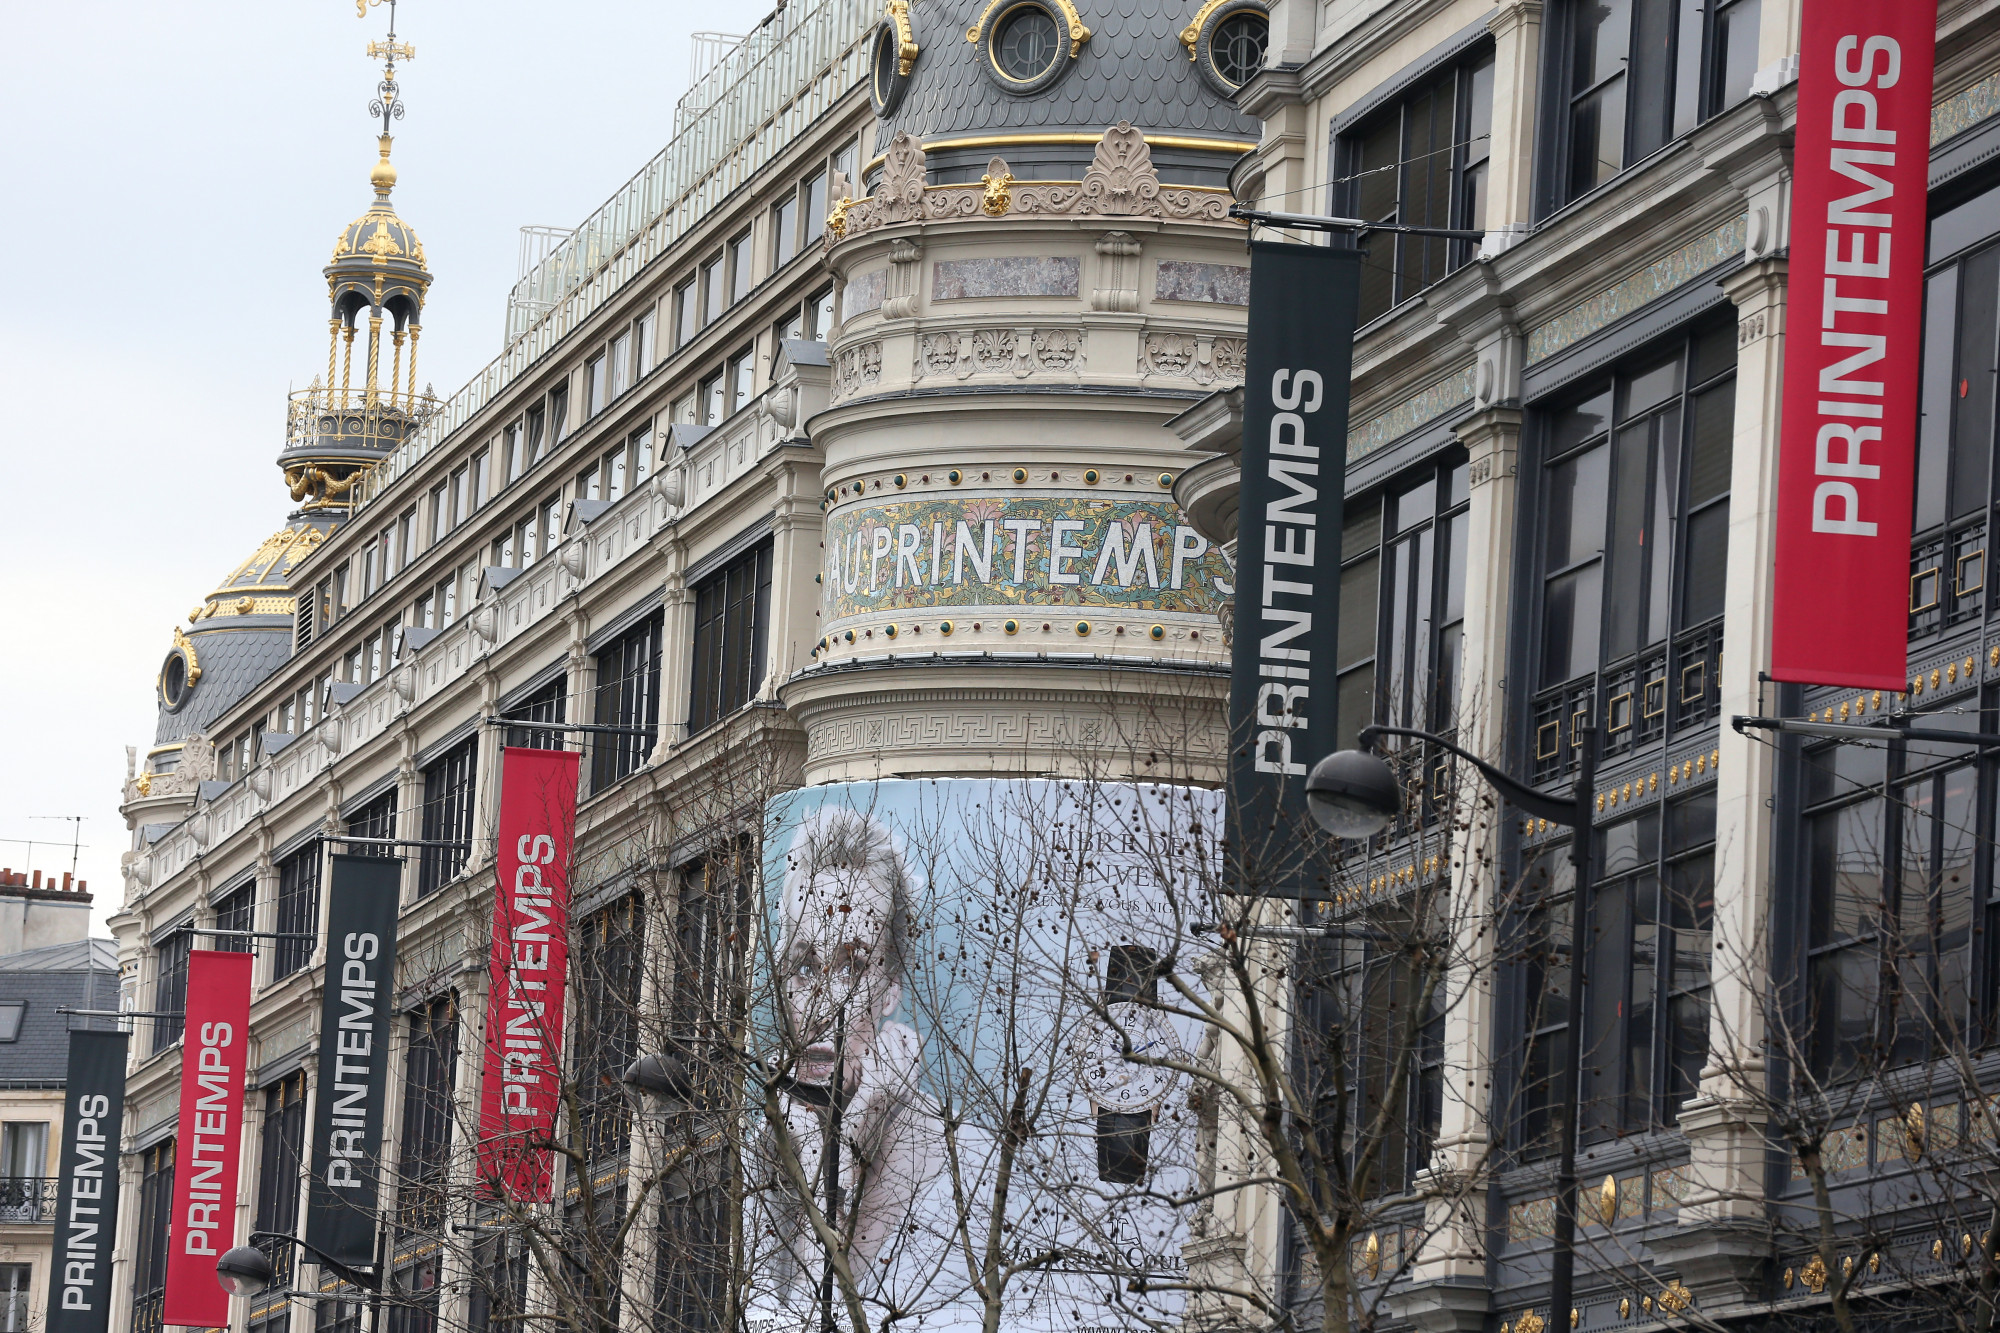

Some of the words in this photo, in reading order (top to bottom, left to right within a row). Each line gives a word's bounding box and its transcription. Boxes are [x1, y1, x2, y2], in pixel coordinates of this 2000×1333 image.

[1812, 34, 1902, 537] PRINTEMPS
[828, 529, 863, 602] AU
[1255, 368, 1325, 776] PRINTEMPS
[327, 932, 379, 1188] PRINTEMPS
[500, 834, 556, 1117] PRINTEMPS
[62, 1094, 109, 1311] PRINTEMPS
[185, 1021, 233, 1256] PRINTEMPS
